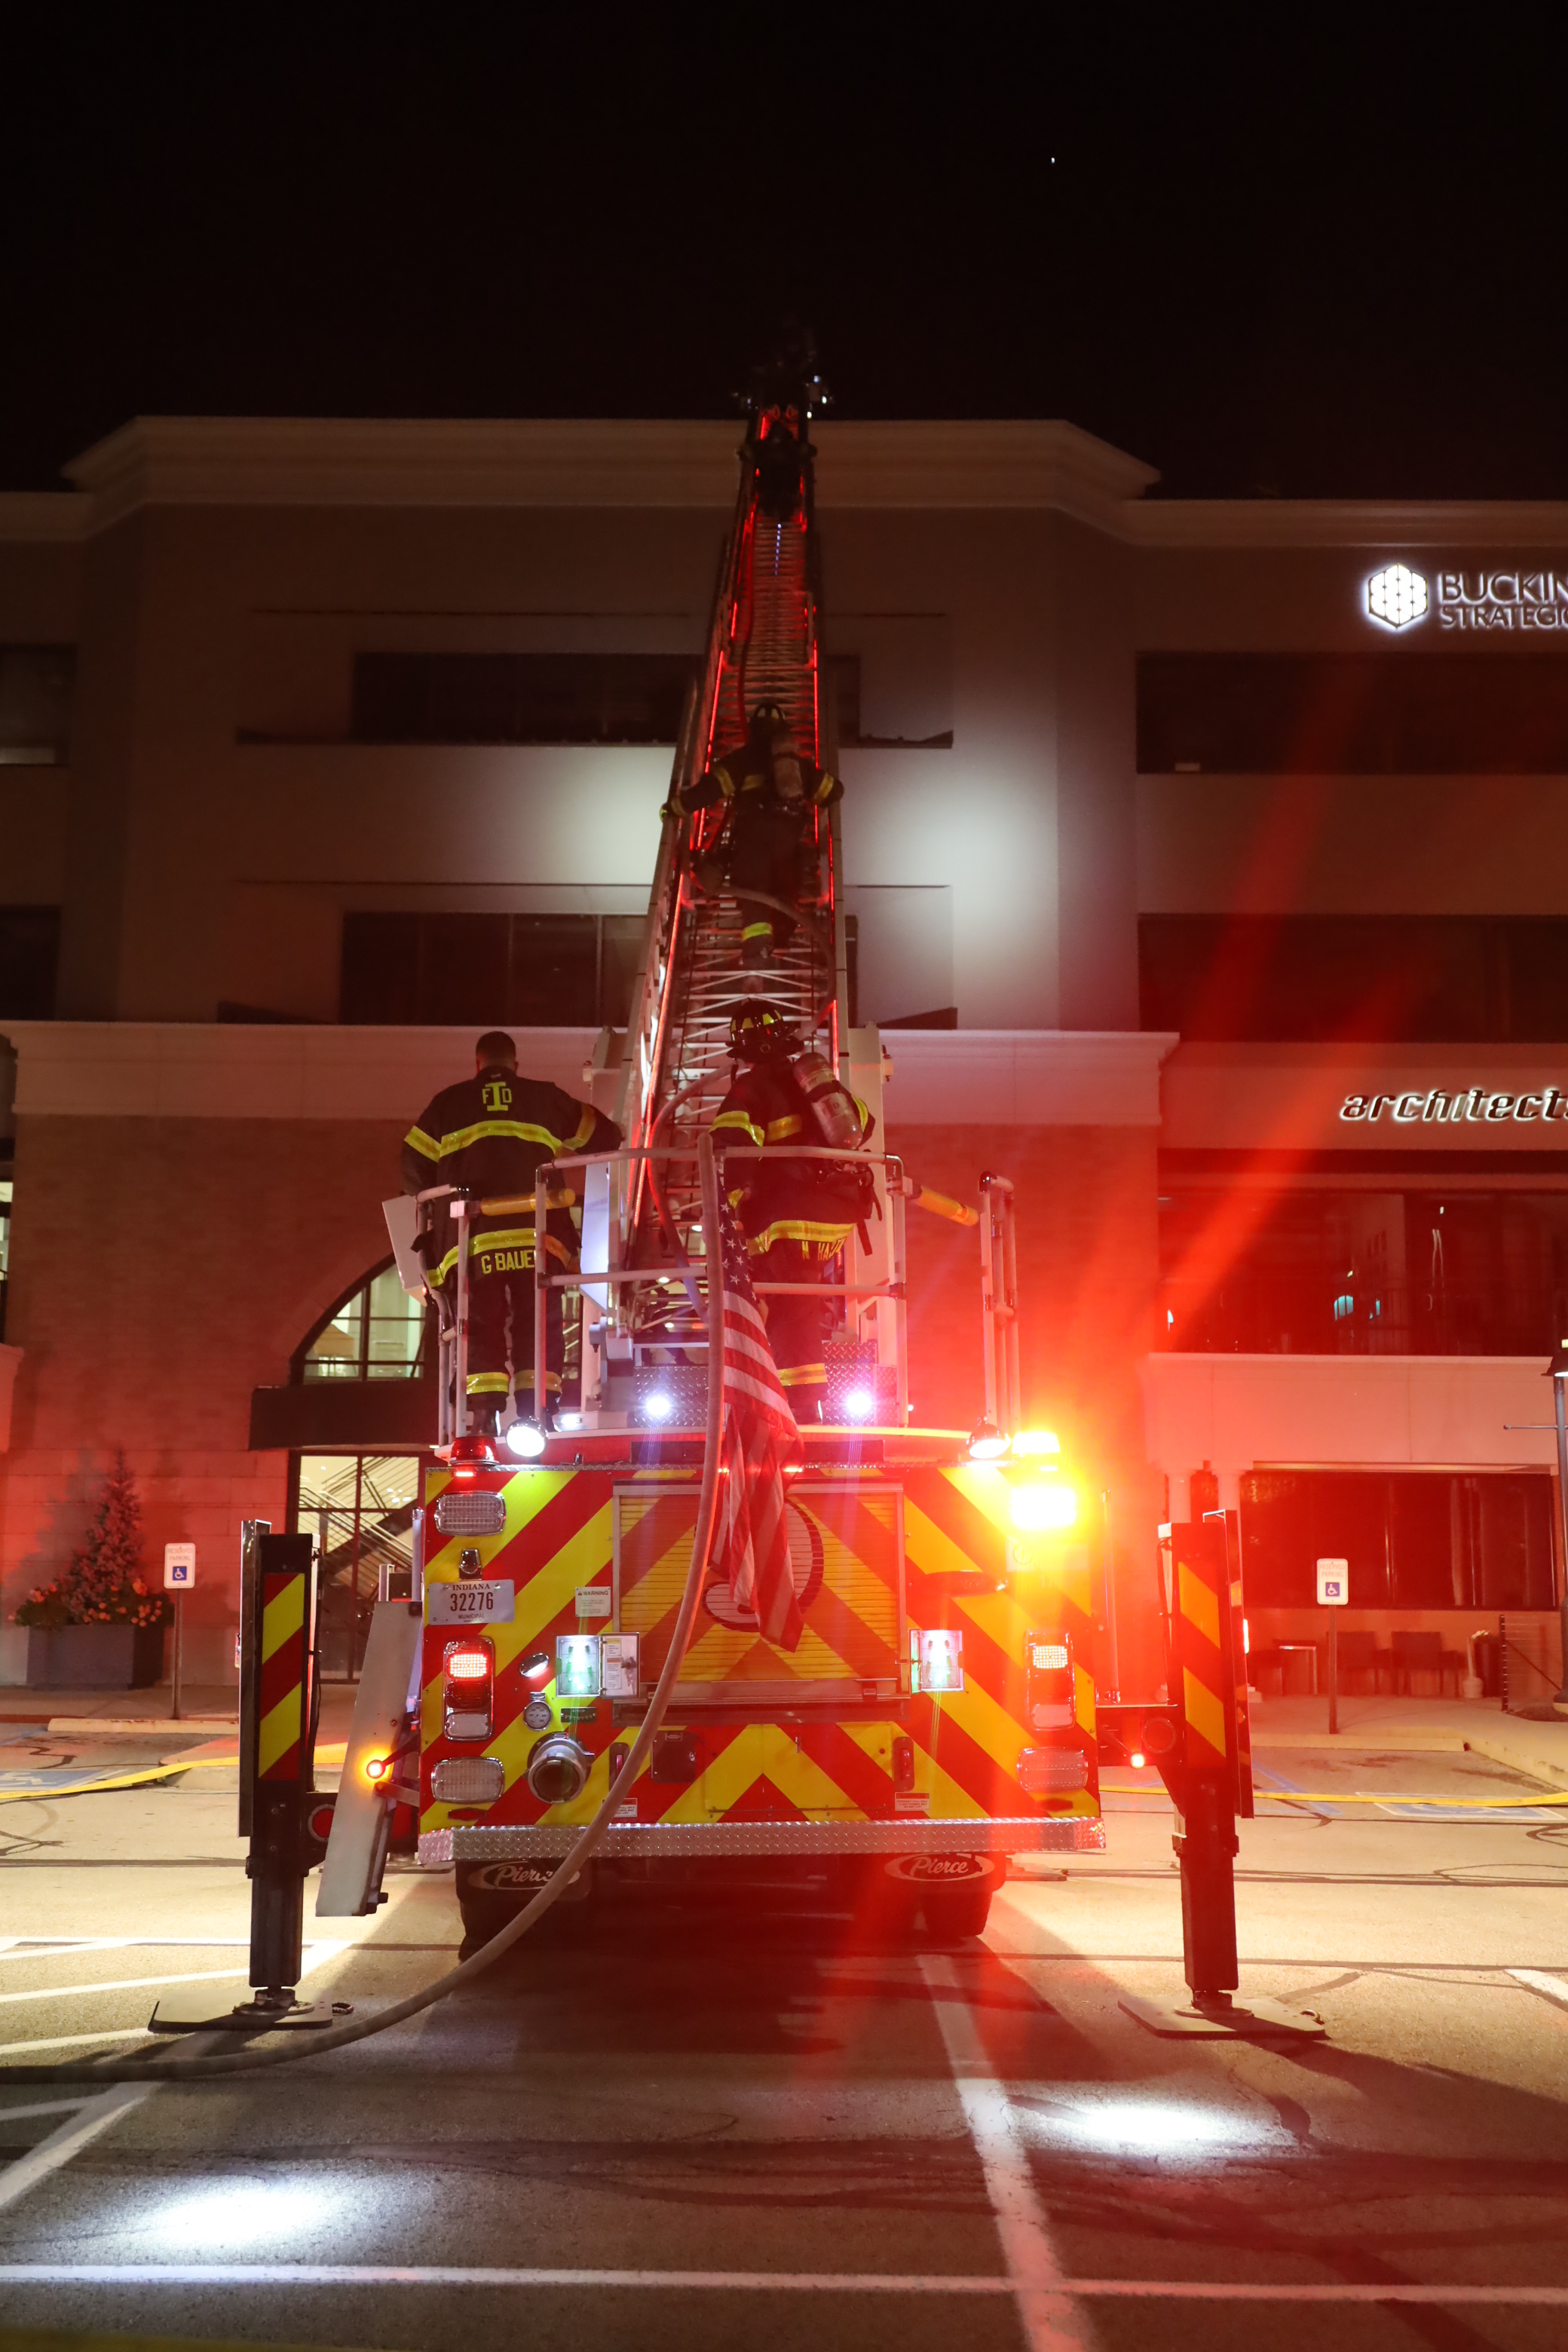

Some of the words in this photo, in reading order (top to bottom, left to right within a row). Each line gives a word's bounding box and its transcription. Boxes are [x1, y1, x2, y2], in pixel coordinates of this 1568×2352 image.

[1340, 1087, 1568, 1121] architect
[481, 1254, 492, 1275] G
[495, 1249, 536, 1271] BAUE
[450, 1591, 494, 1612] 32276
[909, 1856, 969, 1877] Pierce
